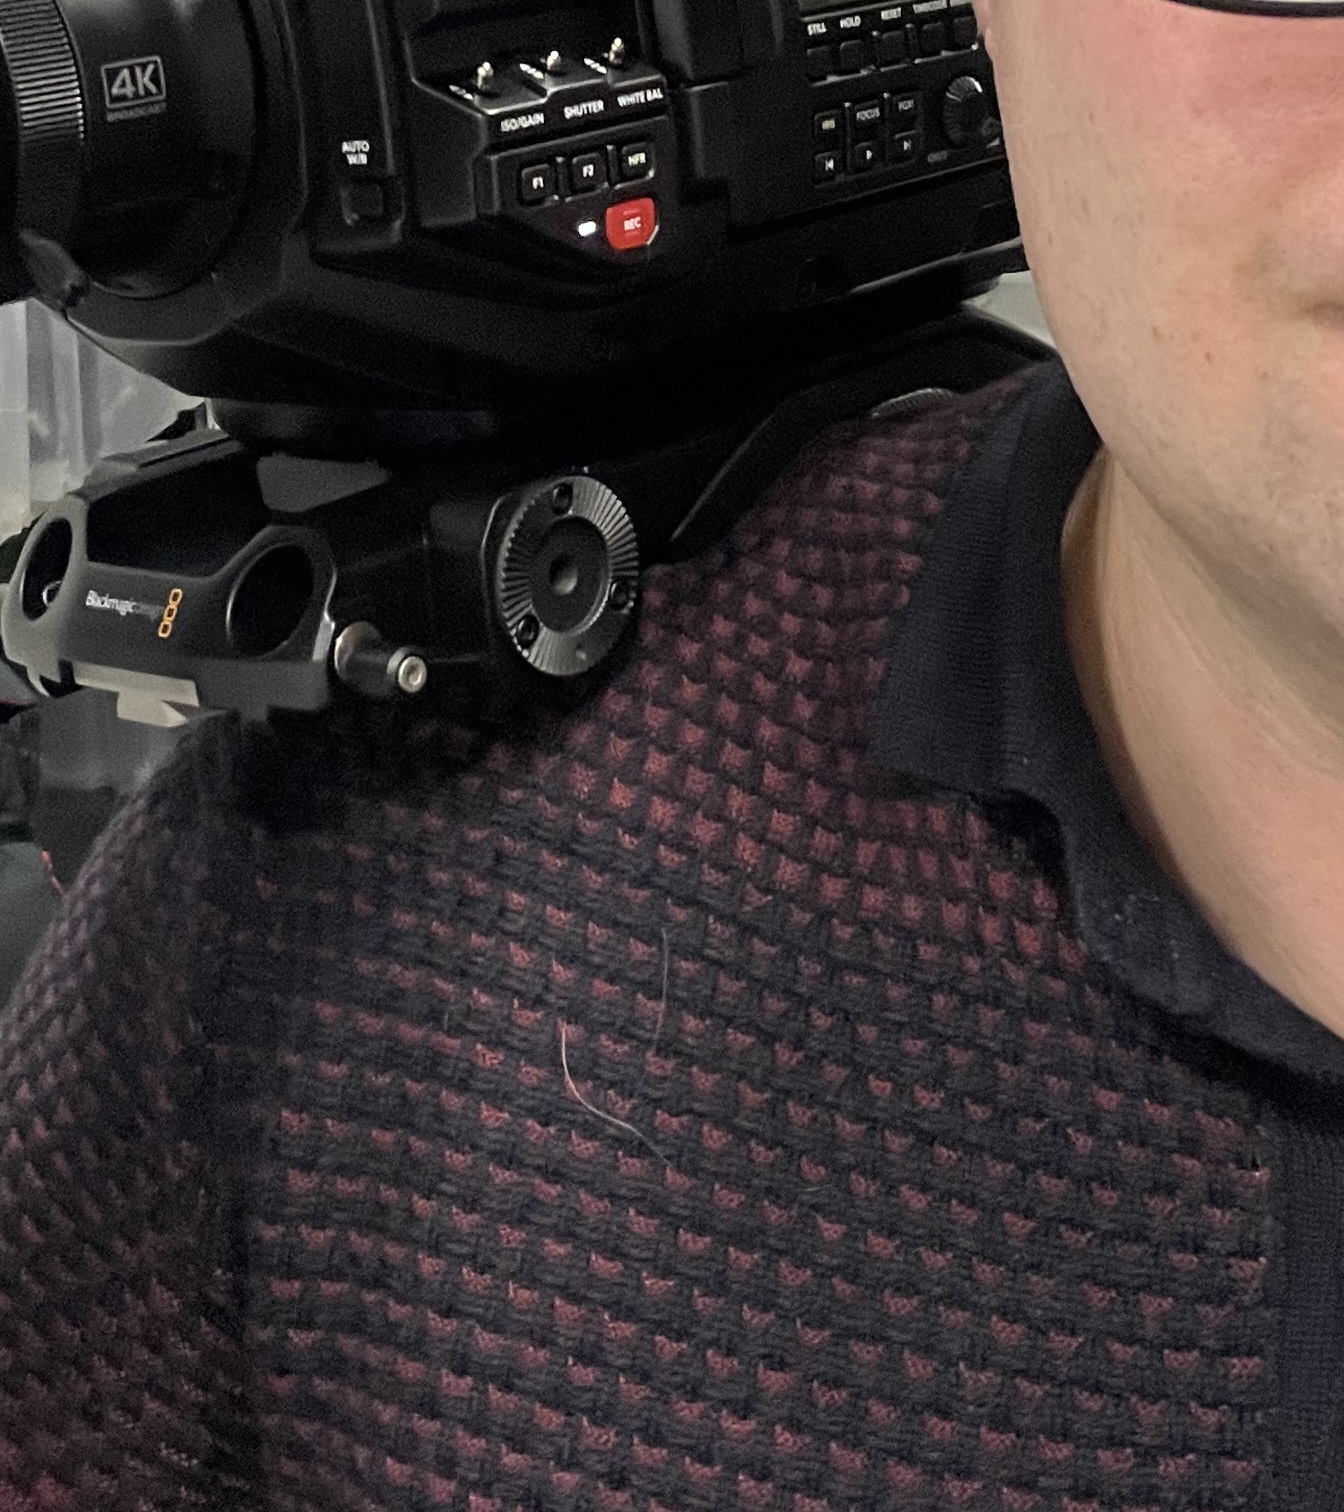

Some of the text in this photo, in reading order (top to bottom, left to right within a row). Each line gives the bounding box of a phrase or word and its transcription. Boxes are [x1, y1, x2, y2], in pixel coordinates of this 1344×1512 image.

[110, 63, 159, 99] 4K
[618, 88, 663, 107] WHITE BAL
[564, 100, 605, 119] SHUTTER
[342, 140, 370, 154] AUTO
[624, 217, 641, 232] REC
